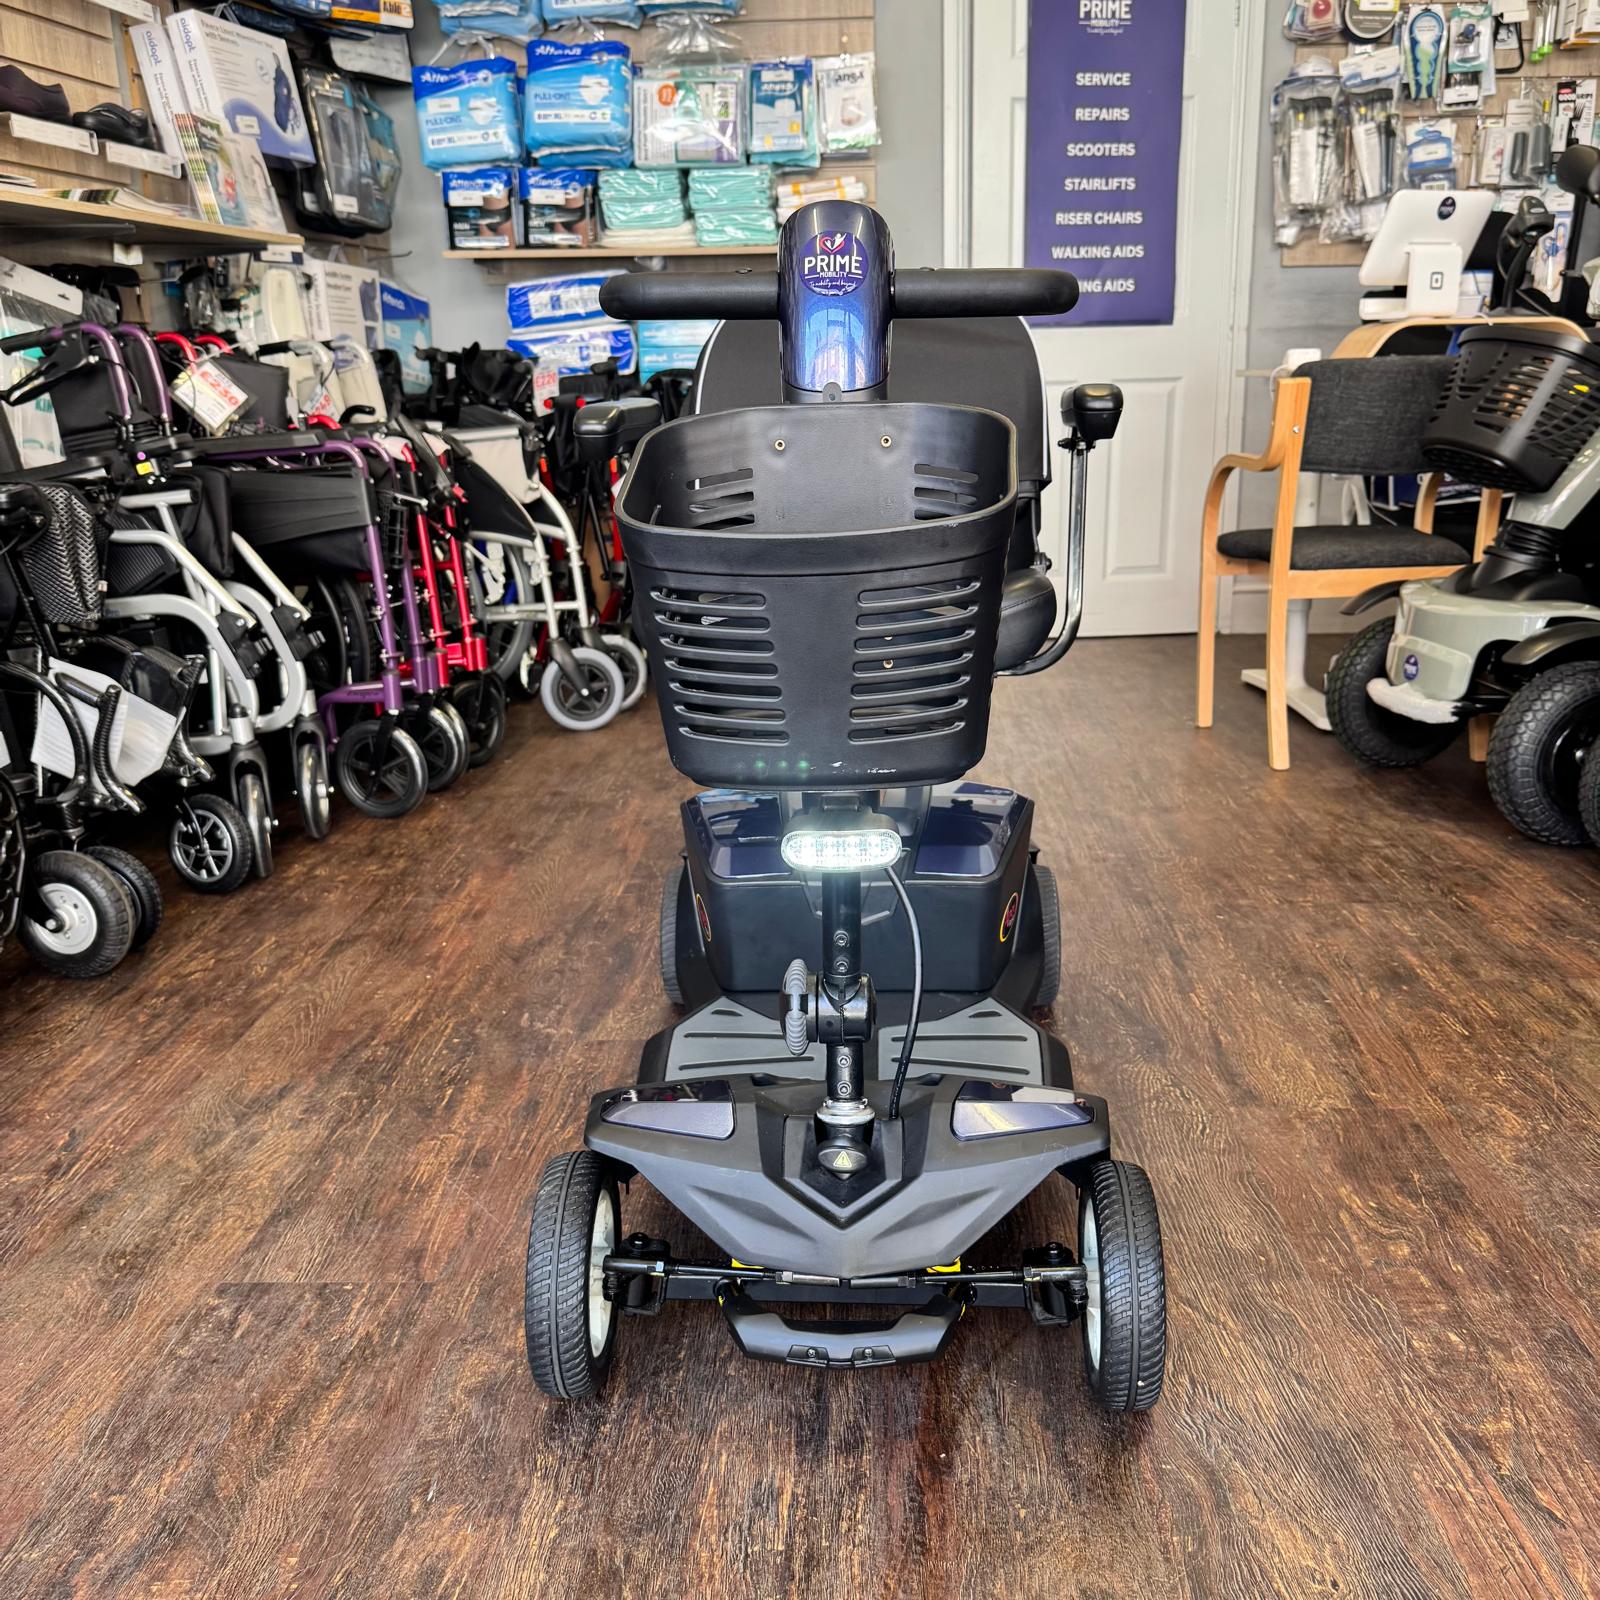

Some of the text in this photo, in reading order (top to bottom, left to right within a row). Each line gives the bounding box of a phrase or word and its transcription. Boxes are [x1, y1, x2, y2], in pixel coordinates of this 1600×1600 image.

[1079, 0, 1132, 19] PRIME
[1076, 72, 1131, 86] SERVICE
[1075, 107, 1130, 121] REPAIRS
[1066, 143, 1136, 157] SCOOTERS
[1064, 177, 1136, 191] STAIRLIFTS
[1055, 211, 1143, 225] RISER CHAIRS
[1051, 245, 1144, 259] WALKING AIDS
[804, 255, 863, 275] PRIME
[1103, 279, 1135, 292] AIDS
